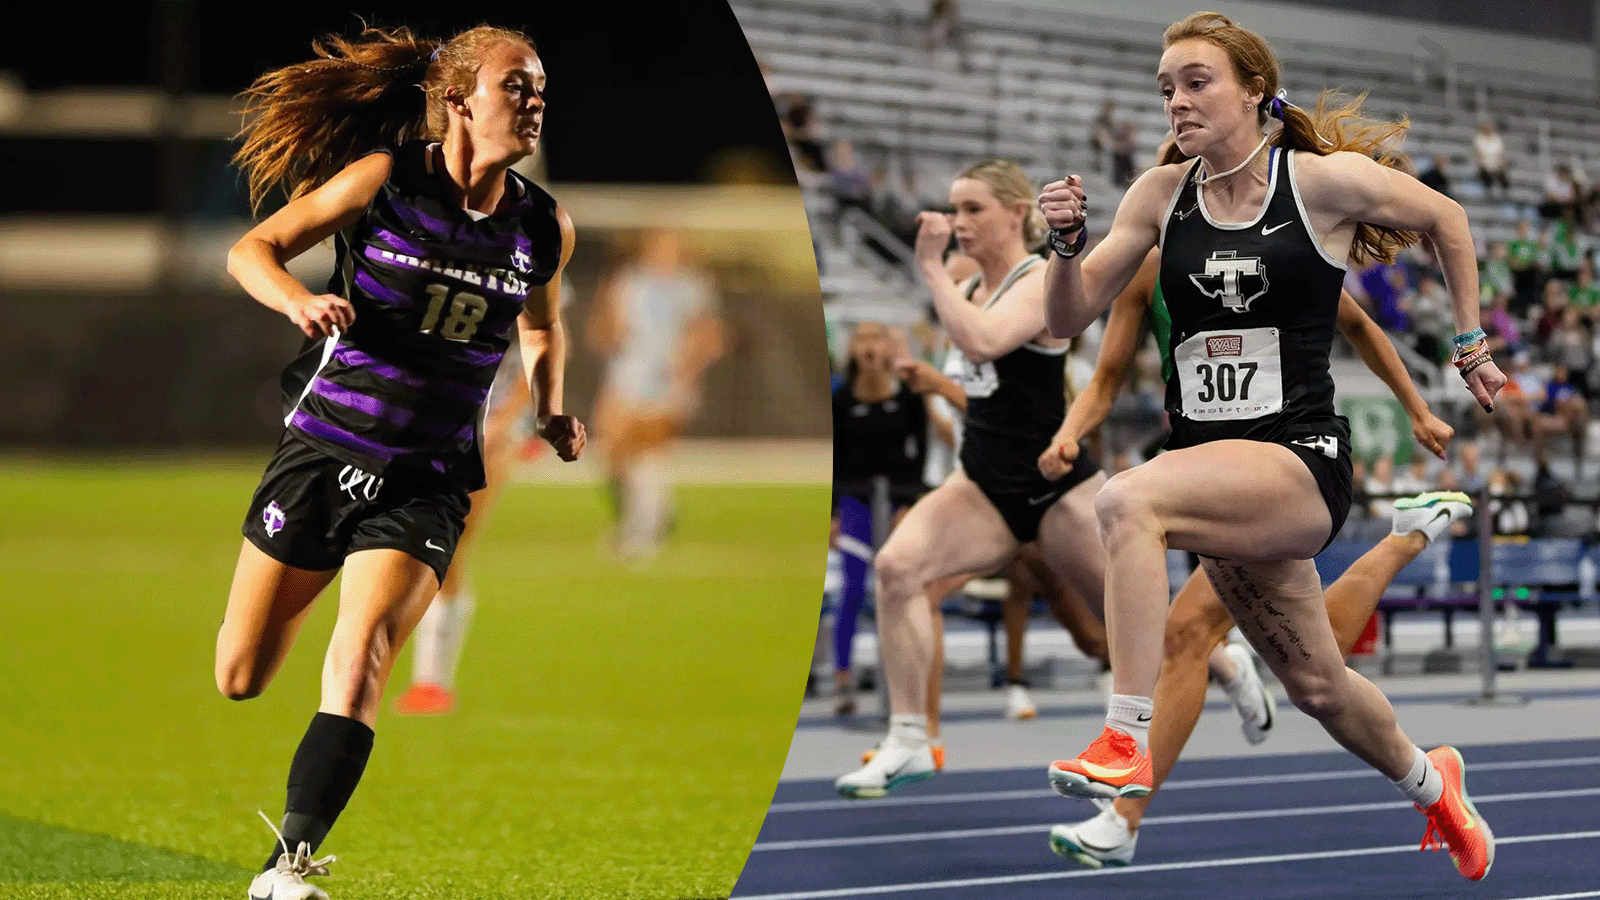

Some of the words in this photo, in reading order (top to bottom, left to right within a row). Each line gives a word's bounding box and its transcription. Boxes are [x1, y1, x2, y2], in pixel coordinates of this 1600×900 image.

[418, 283, 488, 343] 18
[1209, 338, 1240, 351] WAC
[1196, 362, 1258, 403] 307
